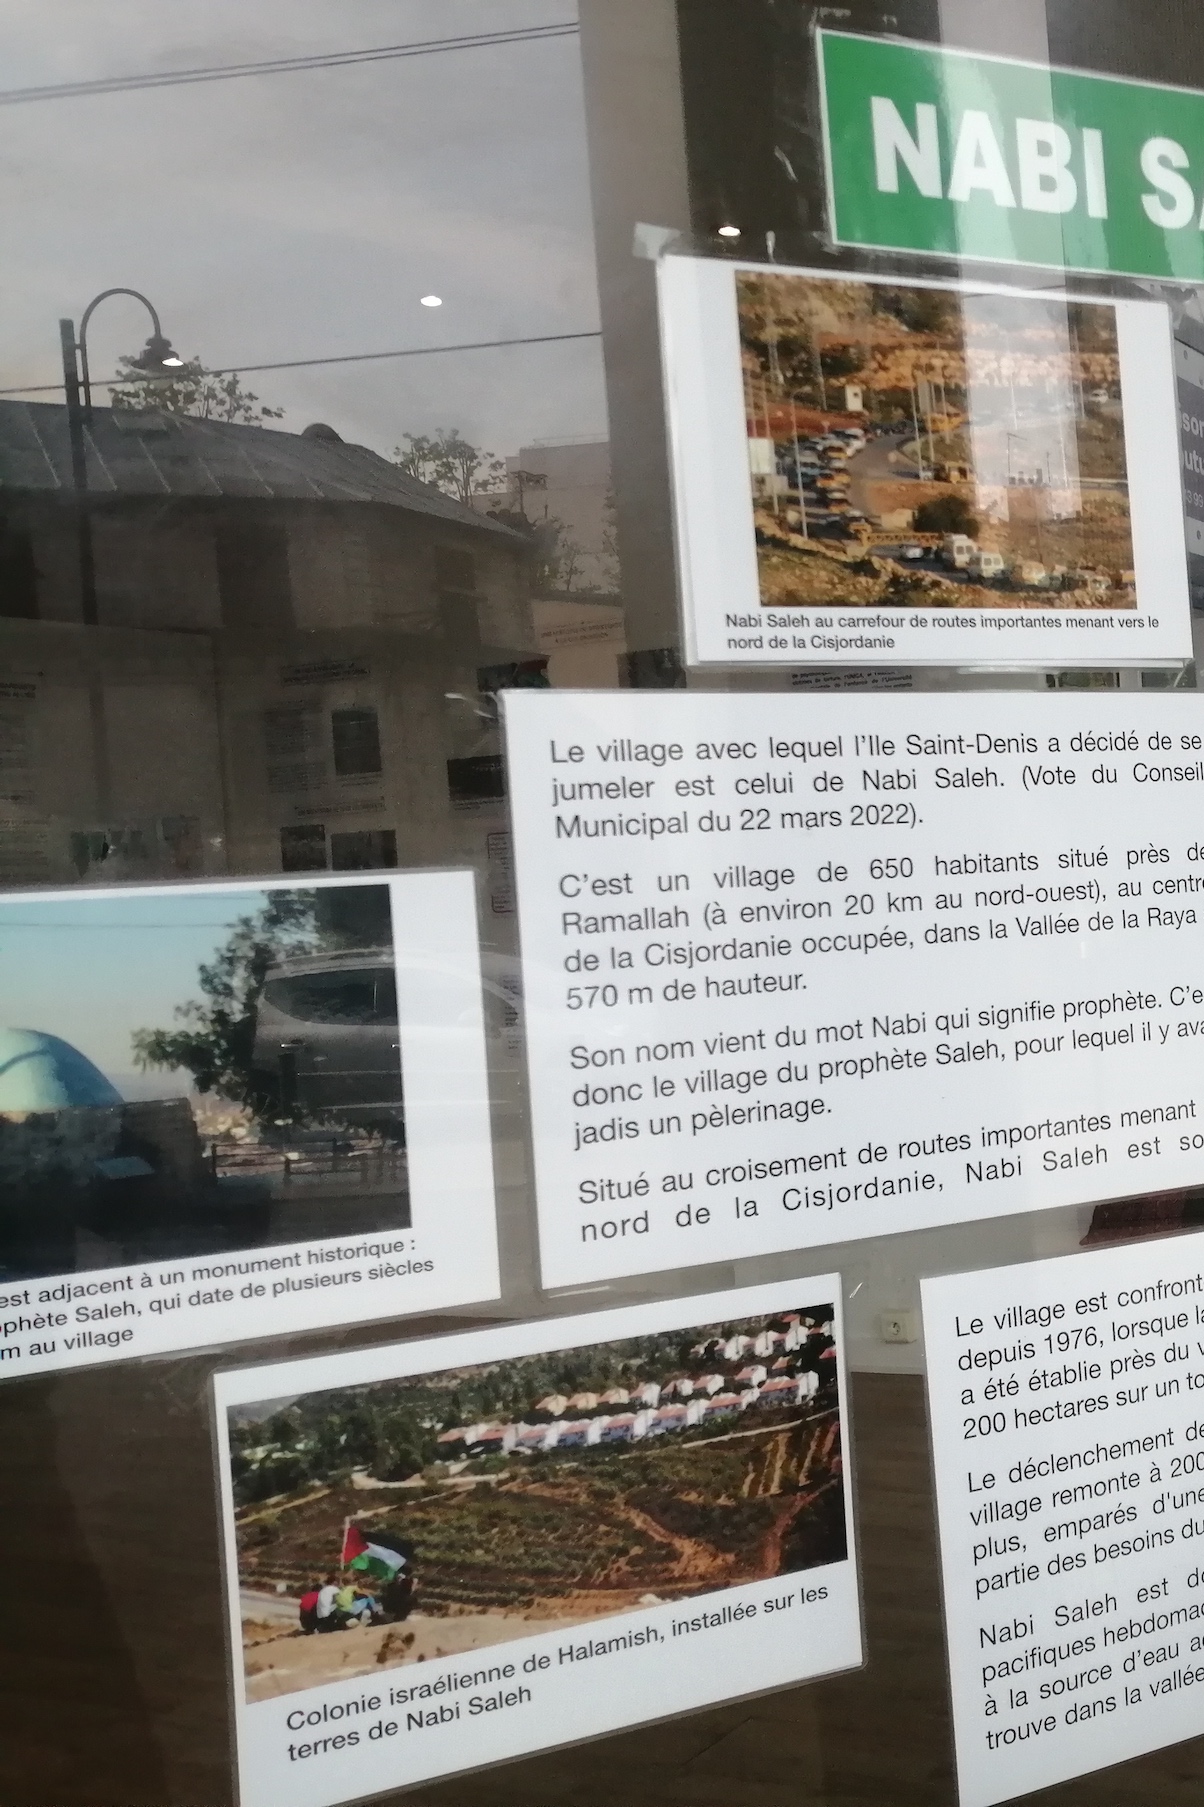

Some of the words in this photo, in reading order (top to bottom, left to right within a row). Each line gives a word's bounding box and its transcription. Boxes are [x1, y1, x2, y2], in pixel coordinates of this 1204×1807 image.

[870, 95, 1108, 219] NABI
[725, 613, 762, 628] Nabi
[766, 614, 810, 628] Saleh
[814, 617, 834, 628] au
[837, 614, 906, 628] carrefour
[909, 614, 928, 628] de
[932, 615, 976, 628] routes
[980, 615, 1062, 631] importantes
[1066, 616, 1114, 628] menant
[1118, 618, 1145, 628] vers
[1148, 616, 1159, 628] le
[727, 635, 764, 649] nord
[768, 635, 788, 649] de
[792, 635, 806, 648] la
[810, 634, 895, 652] Cisjordanie
[550, 740, 585, 763] Le
[596, 739, 684, 767] village
[696, 742, 757, 760] avec
[768, 735, 843, 763] lequel
[854, 734, 896, 756] l'Ile
[906, 732, 1038, 756] Saint-Denis
[1048, 737, 1061, 752] a
[1070, 730, 1139, 752] décidé
[1148, 731, 1172, 750] de
[1180, 736, 1202, 750] se
[552, 776, 655, 807] jumeler
[675, 774, 716, 797] est
[734, 771, 794, 795] celui
[812, 770, 844, 792] de
[862, 768, 916, 791] Nabi
[934, 766, 1004, 789] Saleh.
[1022, 765, 1076, 791] (Vote
[1092, 764, 1118, 784] du
[1133, 761, 1204, 782] Conseil
[555, 811, 688, 841] Municipal
[697, 810, 731, 832] du
[740, 808, 772, 831] 22
[780, 810, 842, 830] mars
[850, 802, 923, 829] 2022).
[38, 1276, 134, 1303] adjacent
[140, 1272, 154, 1288] à
[160, 1272, 184, 1286] un
[192, 1252, 302, 1281] monument
[307, 1241, 404, 1265] historique
[75, 1300, 142, 1322] Saleh,
[149, 1293, 181, 1315] qui
[188, 1288, 234, 1306] date
[240, 1282, 266, 1298] de
[272, 1271, 362, 1298] plusieurs
[367, 1260, 434, 1280] siècles
[955, 1316, 984, 1338] Le
[993, 1304, 1065, 1330] village
[1075, 1292, 1108, 1315] est
[29, 1340, 56, 1356] au
[64, 1329, 134, 1350] village
[968, 1472, 996, 1493] Le
[1008, 1428, 1174, 1484] déclenchement
[286, 1694, 381, 1730] Colonie
[390, 1664, 516, 1706] israélienne
[522, 1654, 551, 1673] de
[558, 1626, 664, 1665] Halamish,
[672, 1602, 757, 1636] installée
[764, 1594, 795, 1613] sur
[801, 1586, 828, 1604] les
[287, 1731, 360, 1762] terres
[368, 1720, 398, 1740] de
[406, 1702, 460, 1732] Nabi
[468, 1686, 532, 1716] Saleh
